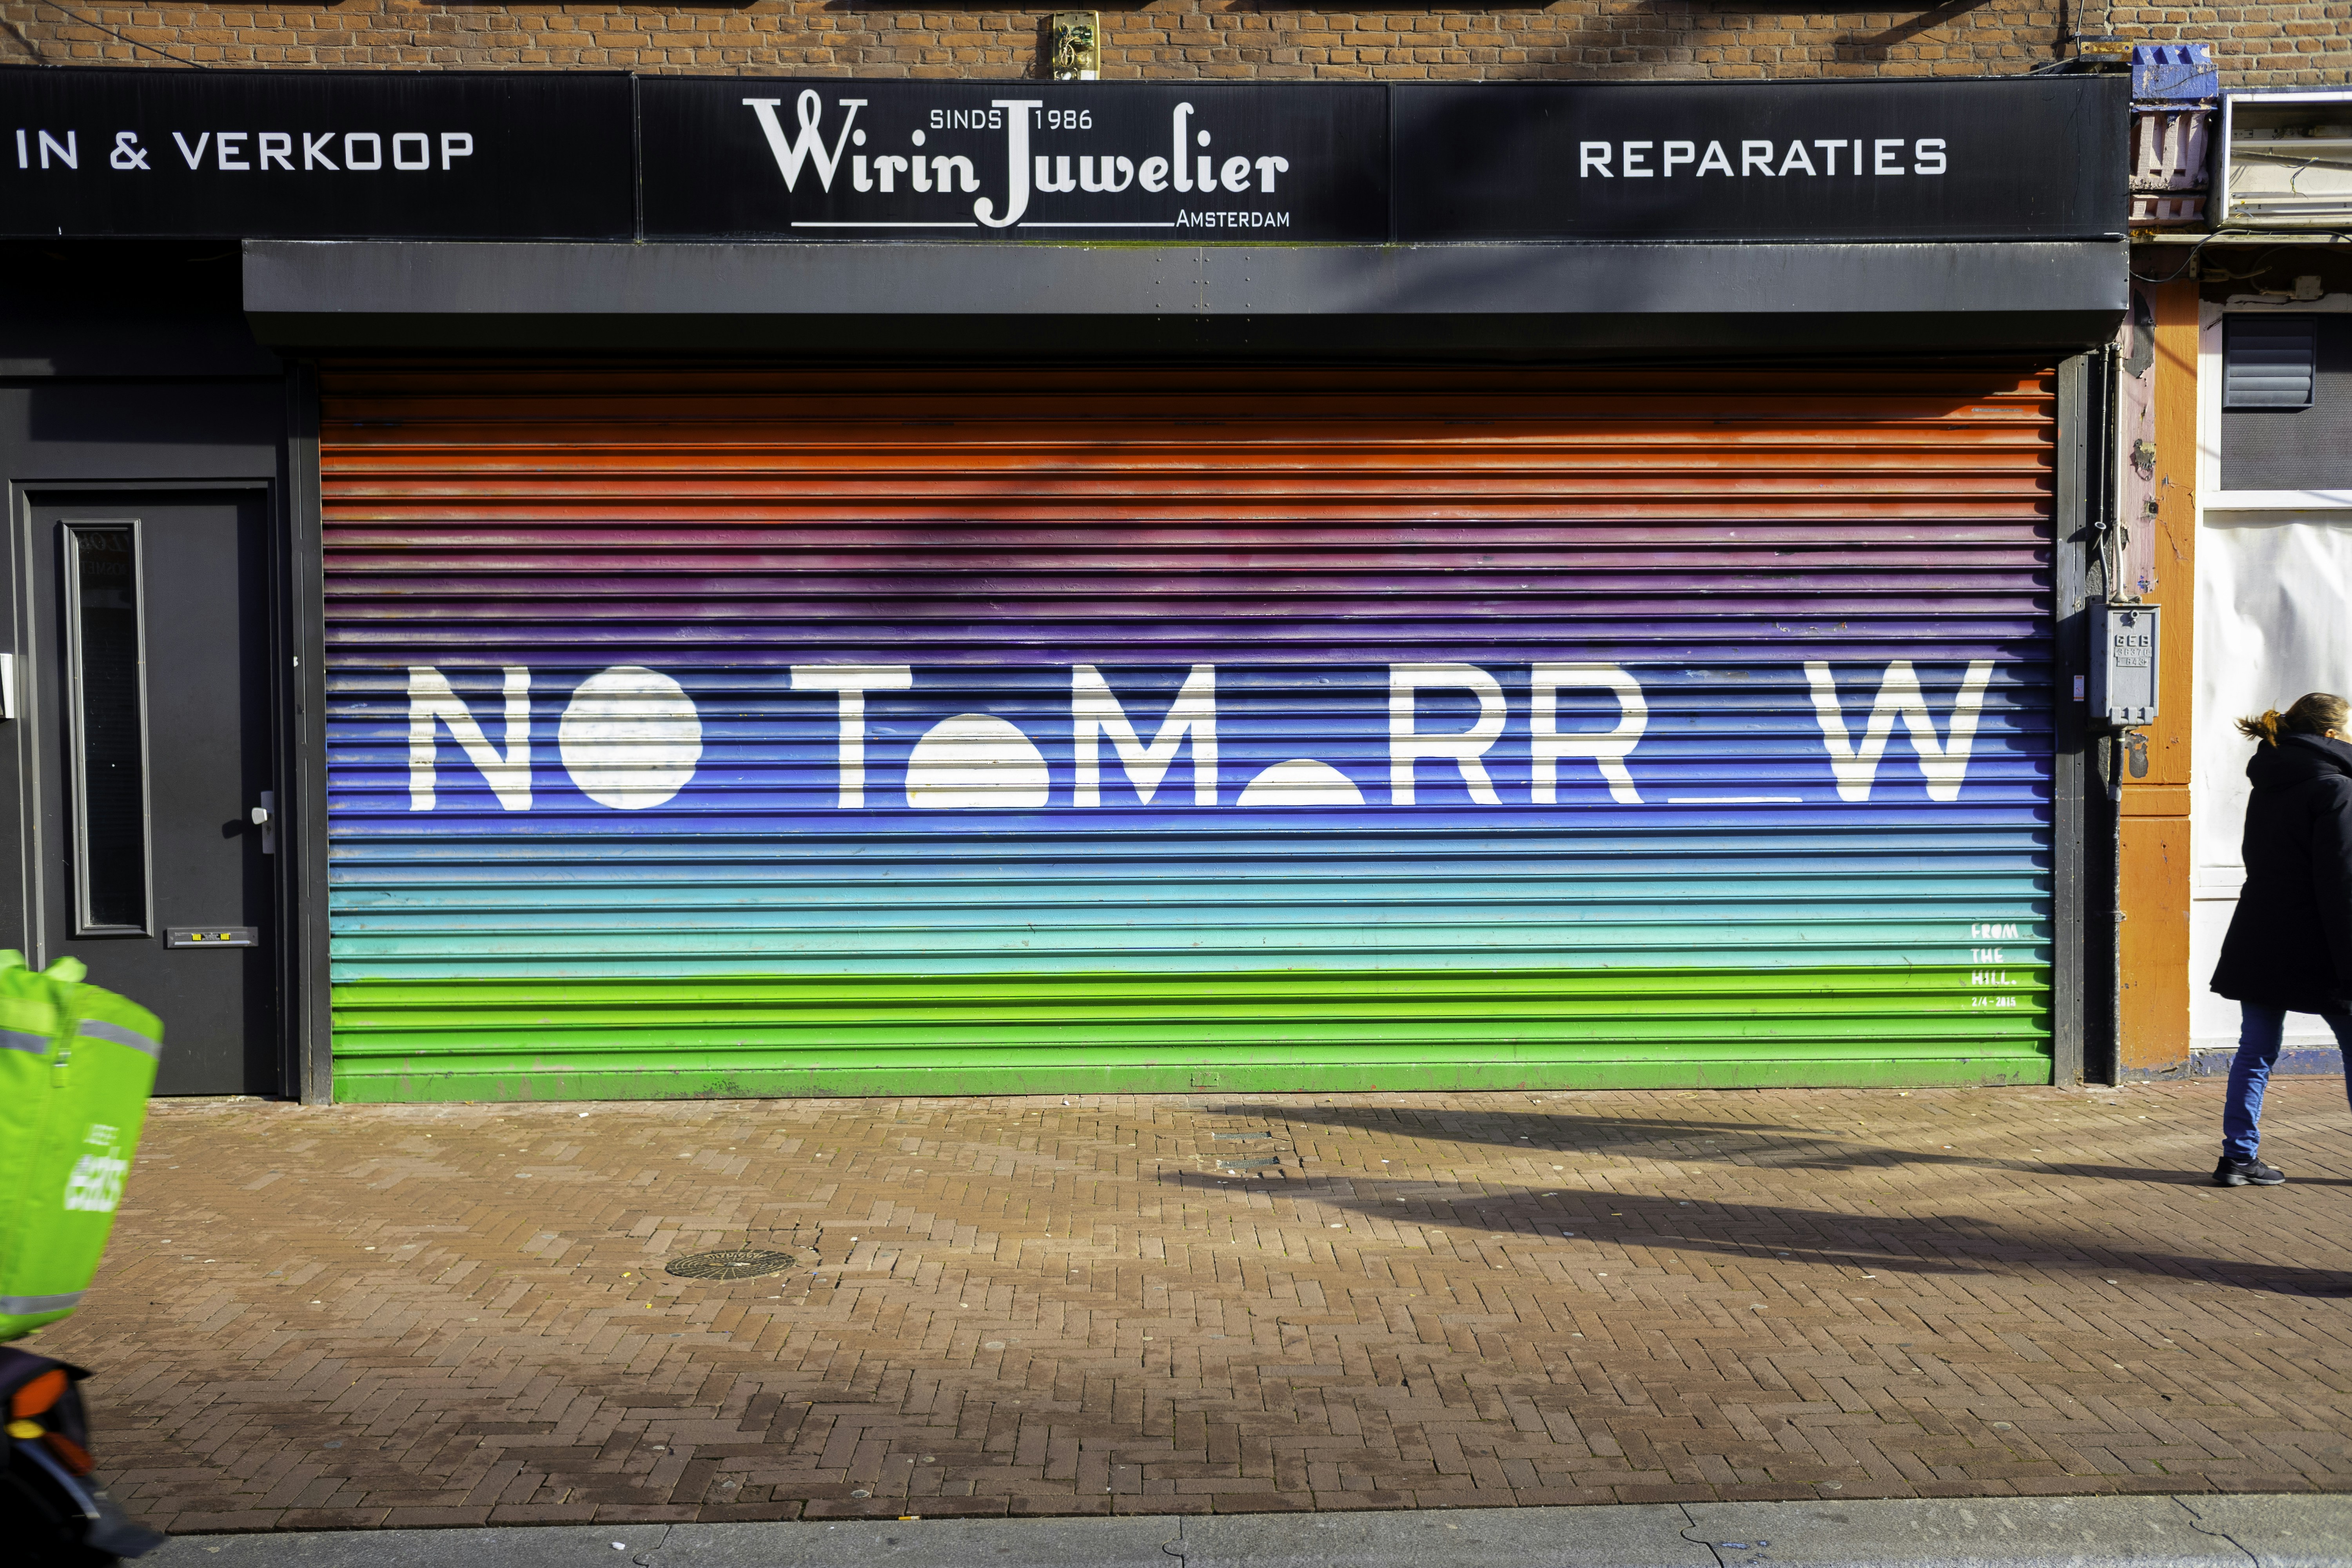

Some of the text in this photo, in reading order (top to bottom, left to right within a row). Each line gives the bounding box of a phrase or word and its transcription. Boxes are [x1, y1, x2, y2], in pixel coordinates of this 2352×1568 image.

[930, 109, 1093, 130] SINDS 1986
[16, 129, 474, 170] IN & VERKOOP
[742, 89, 1289, 228] Wirin Juwelier
[1580, 138, 1947, 178] REPARATIES
[1176, 209, 1290, 227] AMSTERDAM
[408, 665, 703, 811] NO
[1971, 923, 2019, 939] FROM
[1970, 947, 2004, 964] THE
